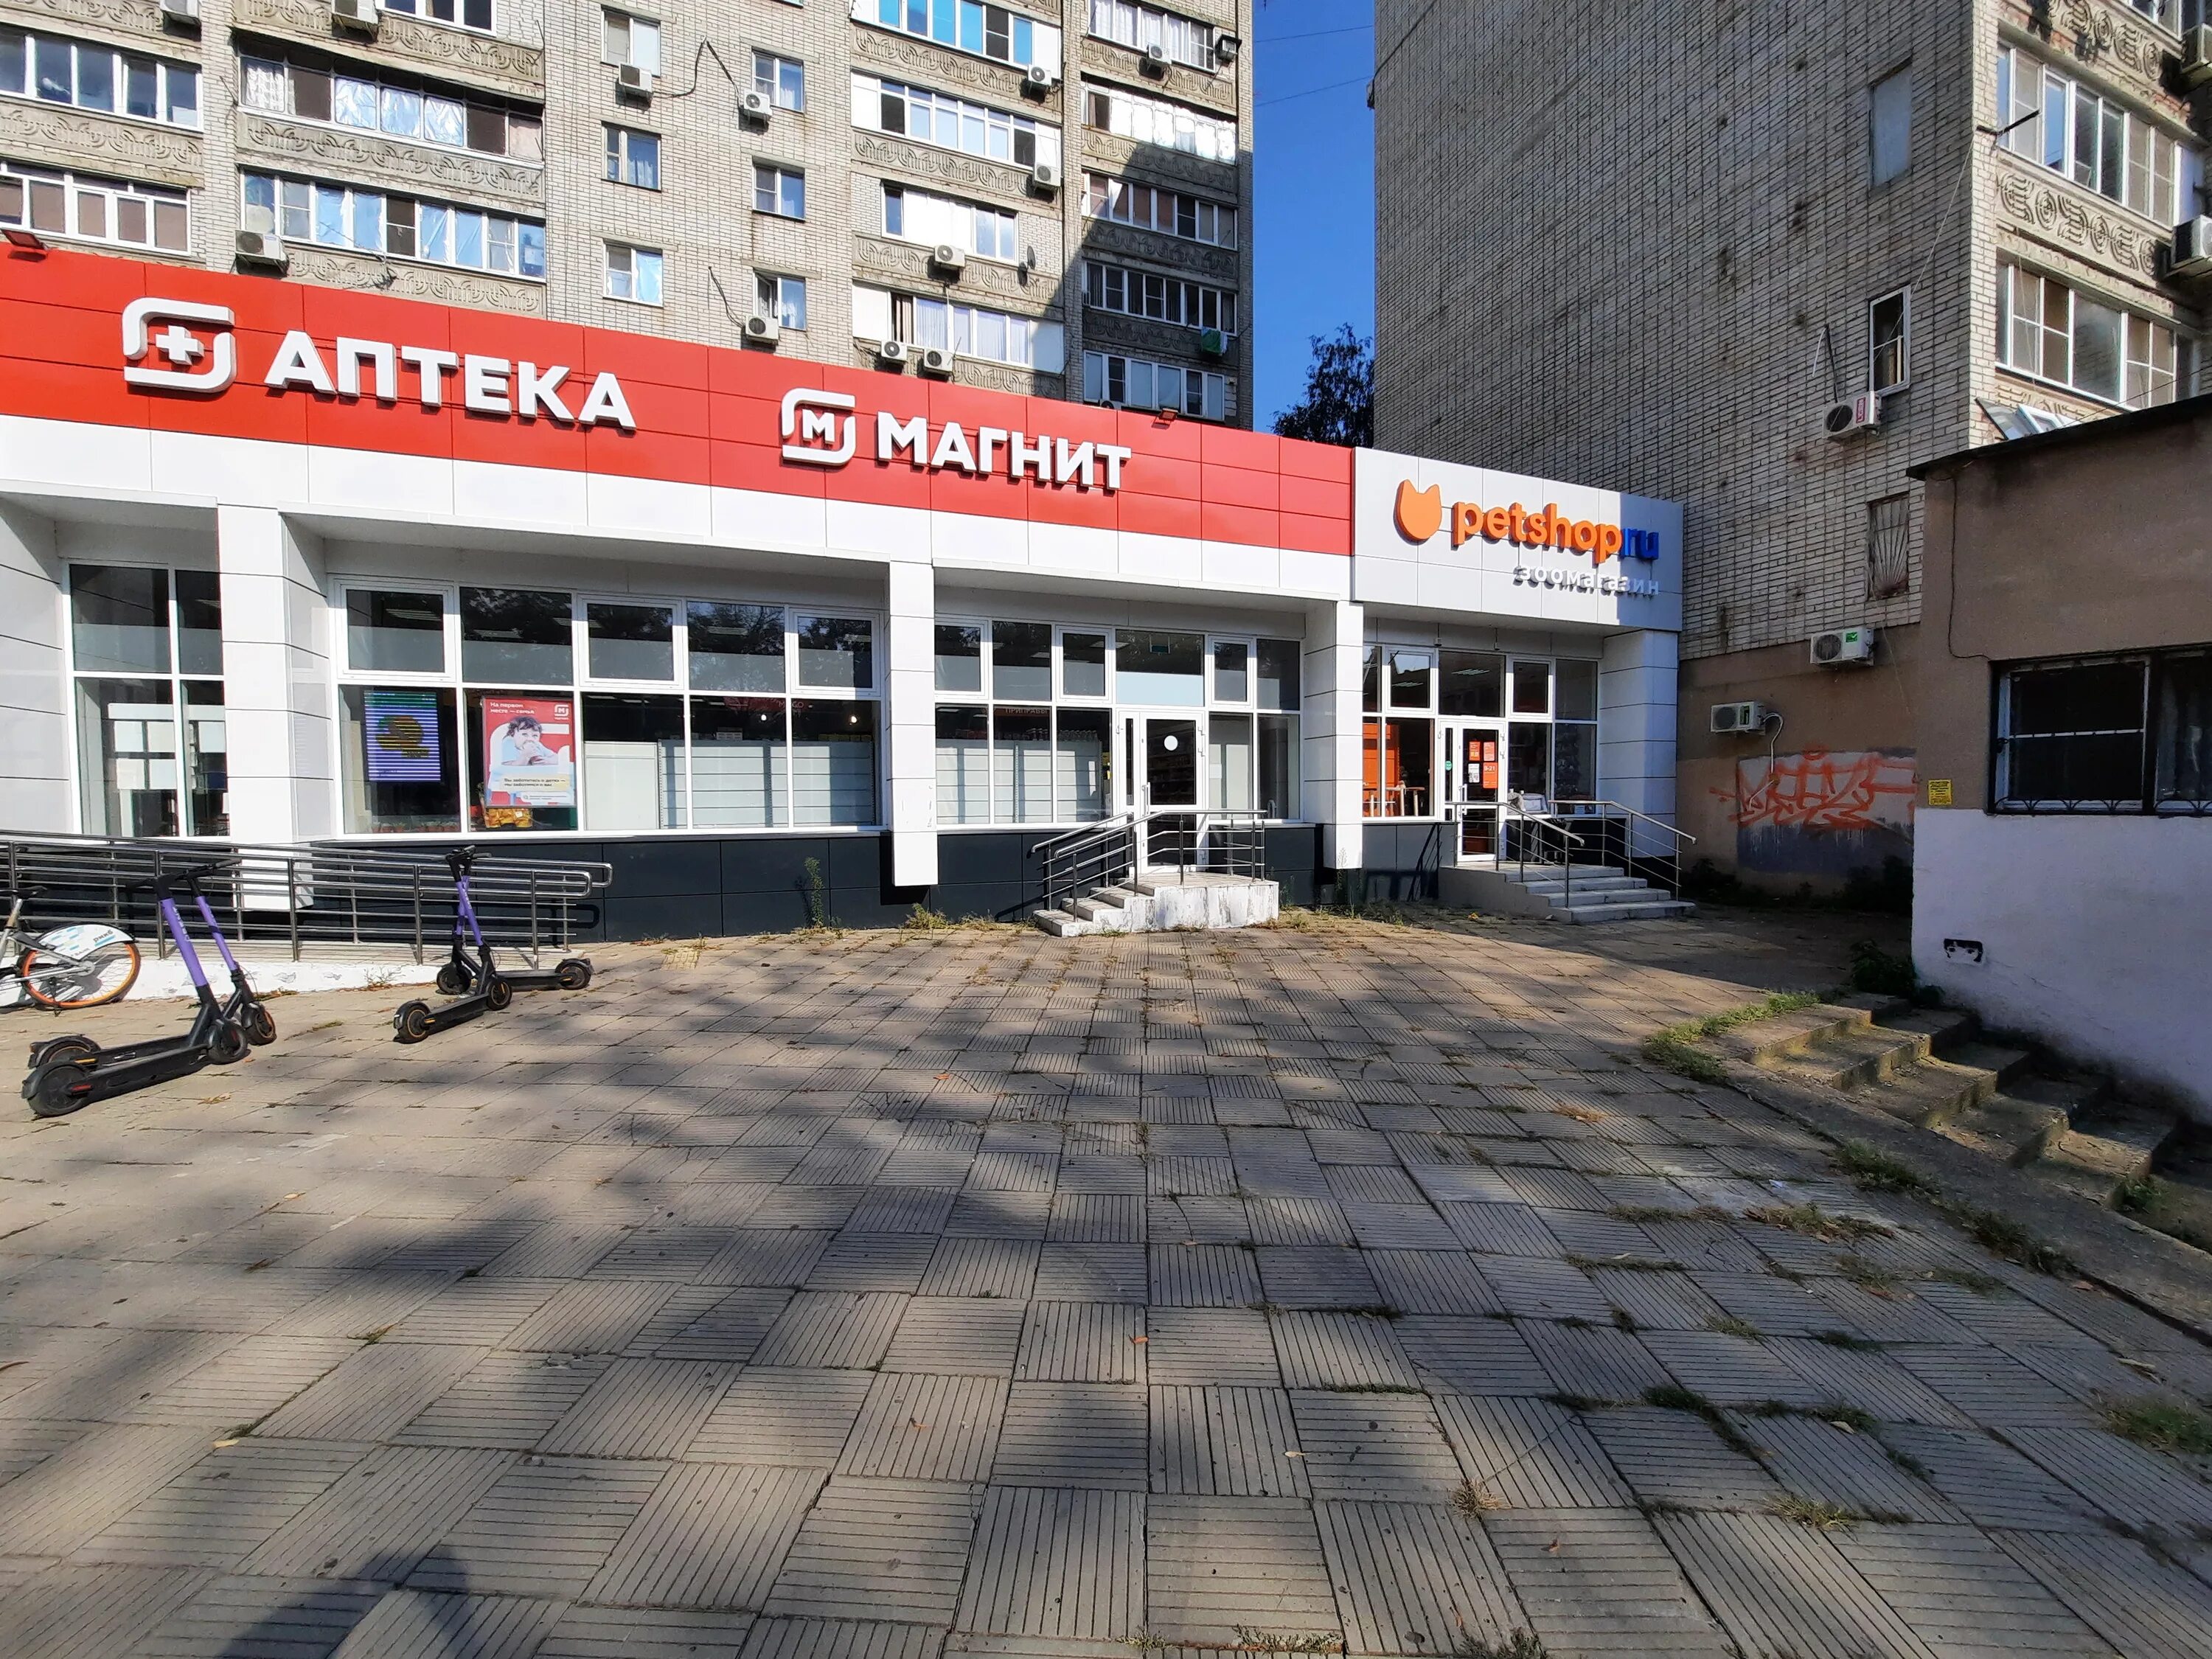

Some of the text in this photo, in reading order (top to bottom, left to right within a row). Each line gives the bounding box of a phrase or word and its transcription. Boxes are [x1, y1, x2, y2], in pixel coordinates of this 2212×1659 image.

[264, 330, 637, 431] АПТЕКА
[877, 411, 1133, 490] МАГНИТ
[1517, 565, 1659, 596] зоомагазин
